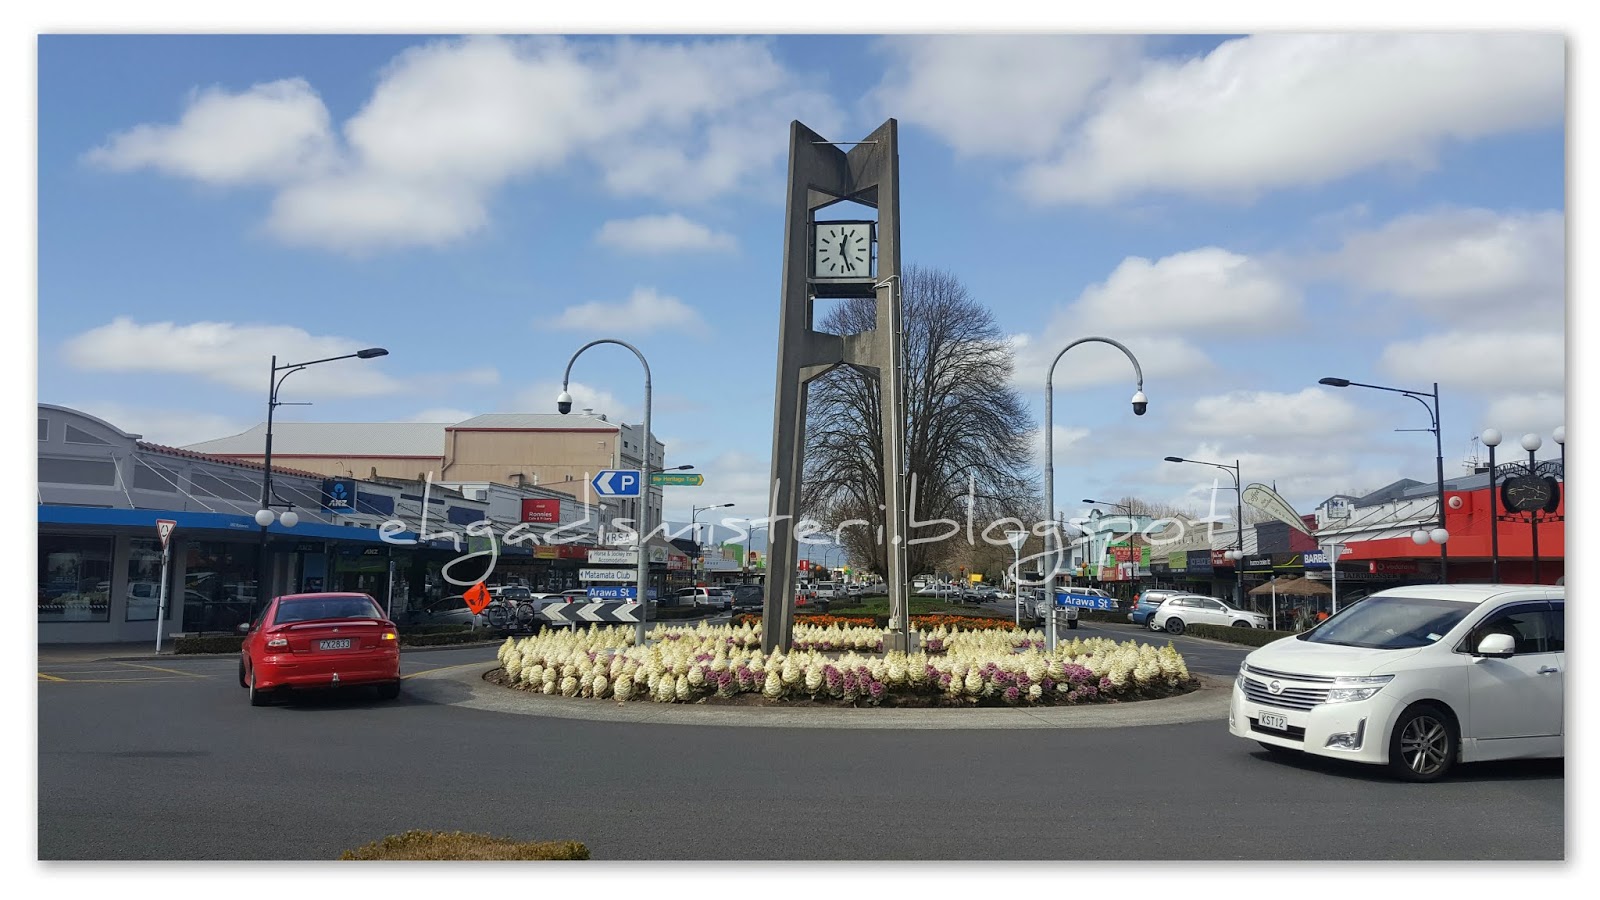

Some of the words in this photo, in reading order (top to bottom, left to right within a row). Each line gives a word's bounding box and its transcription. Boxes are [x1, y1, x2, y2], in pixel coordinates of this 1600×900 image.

[621, 475, 635, 491] P
[328, 499, 348, 507] ANZ
[1304, 553, 1328, 564] BARBE
[584, 571, 615, 579] Matamata
[616, 570, 631, 579] Club
[589, 588, 617, 597] Arawa
[620, 588, 630, 597] St
[1065, 596, 1095, 607] Arawa
[1098, 598, 1108, 608] St
[320, 640, 350, 650] ZX2833
